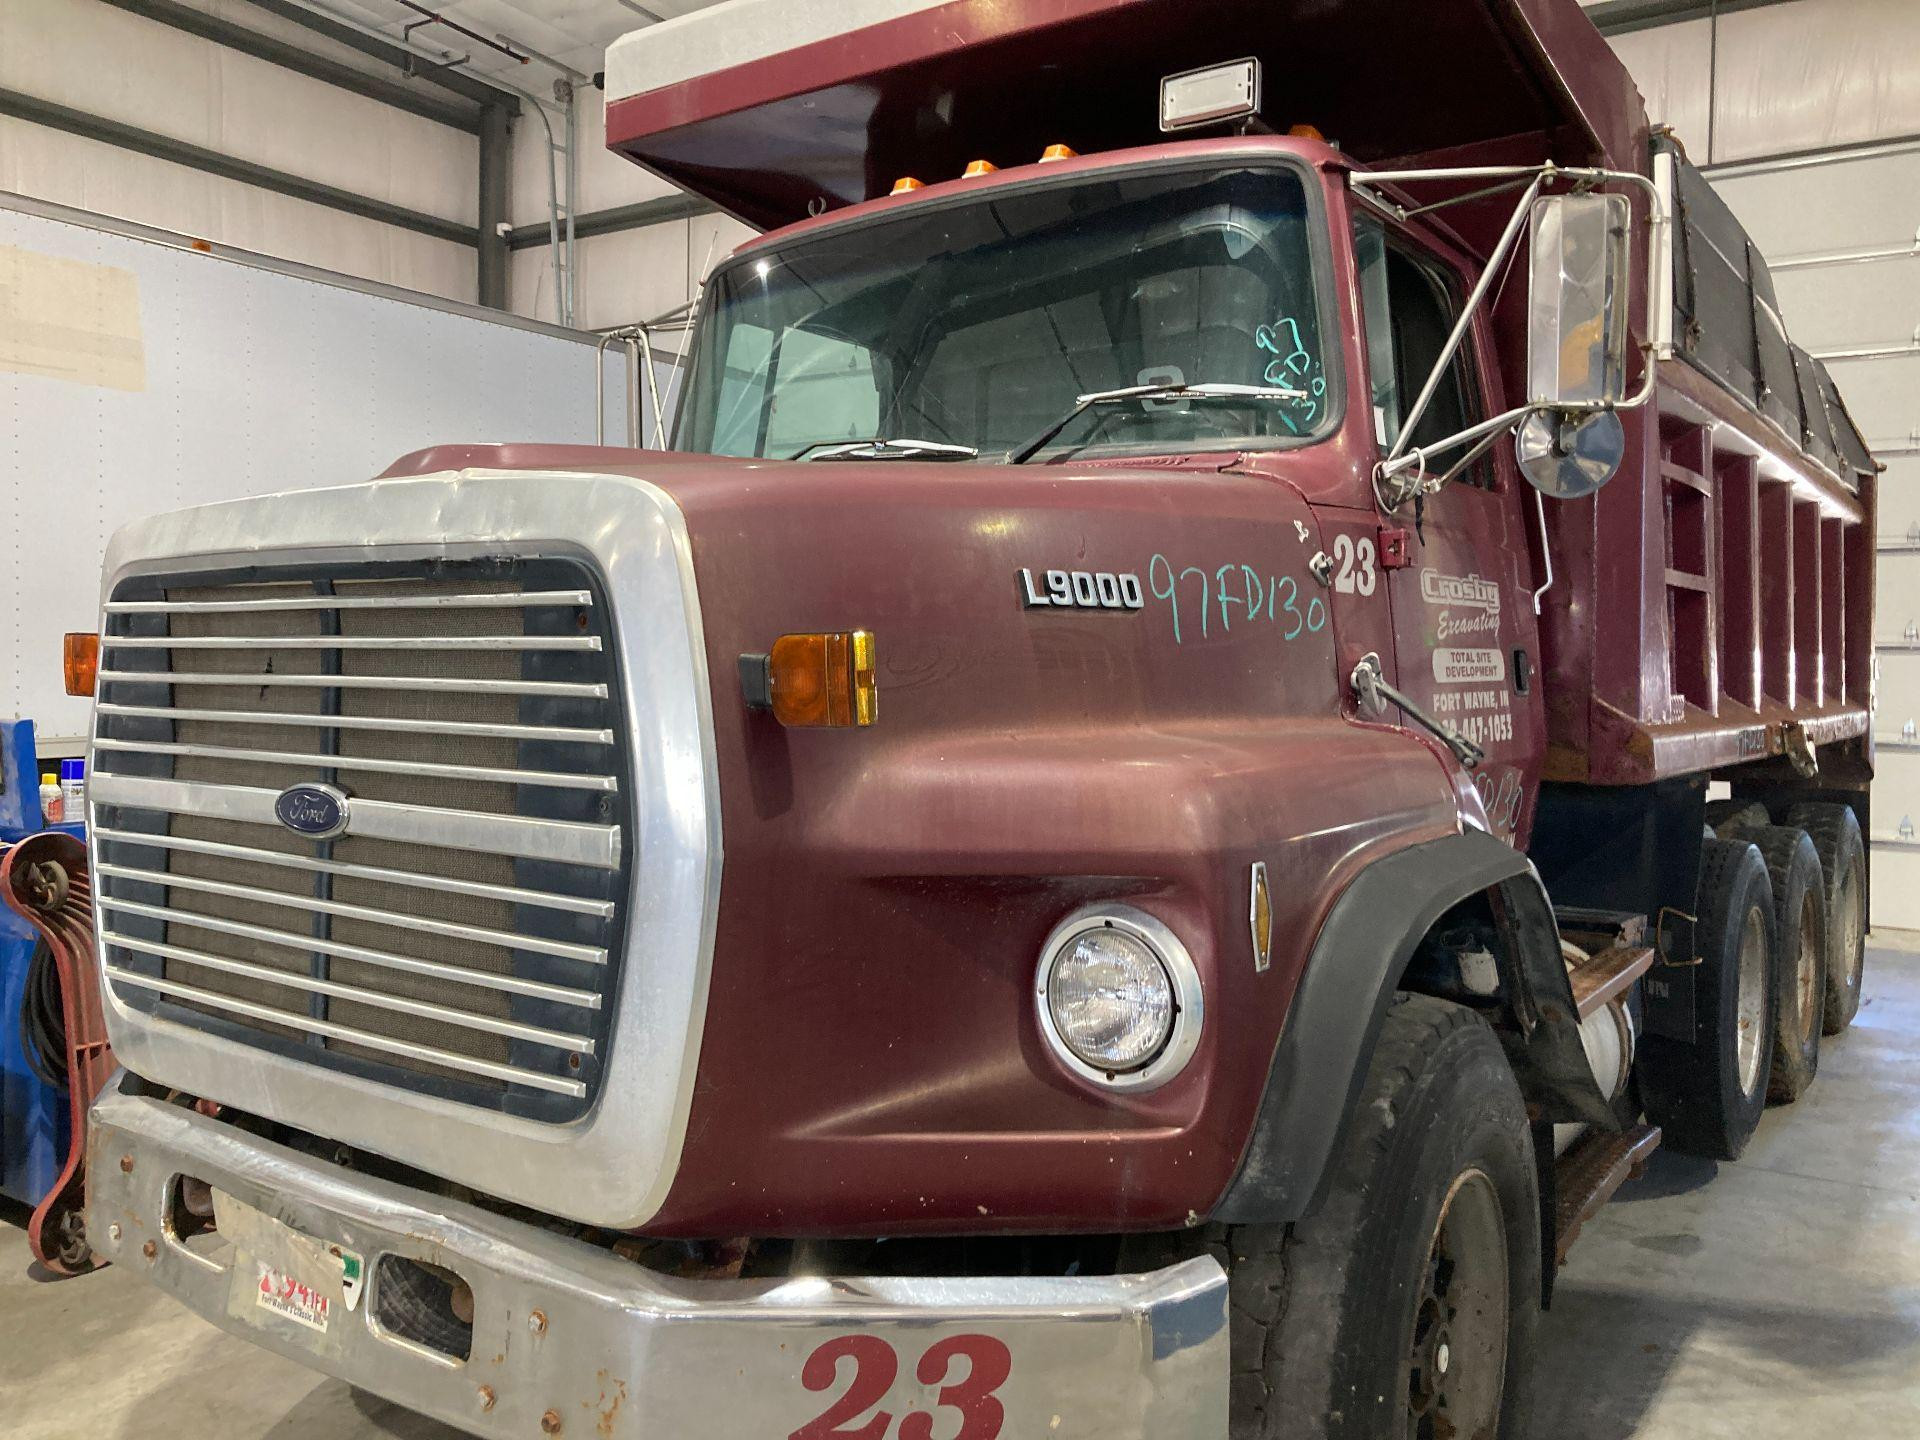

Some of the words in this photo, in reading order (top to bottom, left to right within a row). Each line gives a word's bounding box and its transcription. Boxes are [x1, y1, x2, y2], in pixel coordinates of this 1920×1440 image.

[1333, 533, 1376, 597] 23
[1020, 567, 1145, 610] L9000
[1148, 553, 1326, 645] 97FD130
[1421, 567, 1501, 614] Crosby
[1437, 610, 1500, 640] Excavating
[1445, 664, 1498, 678] DEVELOPMENT
[1450, 651, 1475, 664] TOTAL
[1476, 651, 1492, 664] SITE
[1432, 691, 1461, 712] FORT
[1499, 690, 1510, 707] IN
[289, 794, 329, 824] Ford
[787, 1333, 1012, 1440] 23
